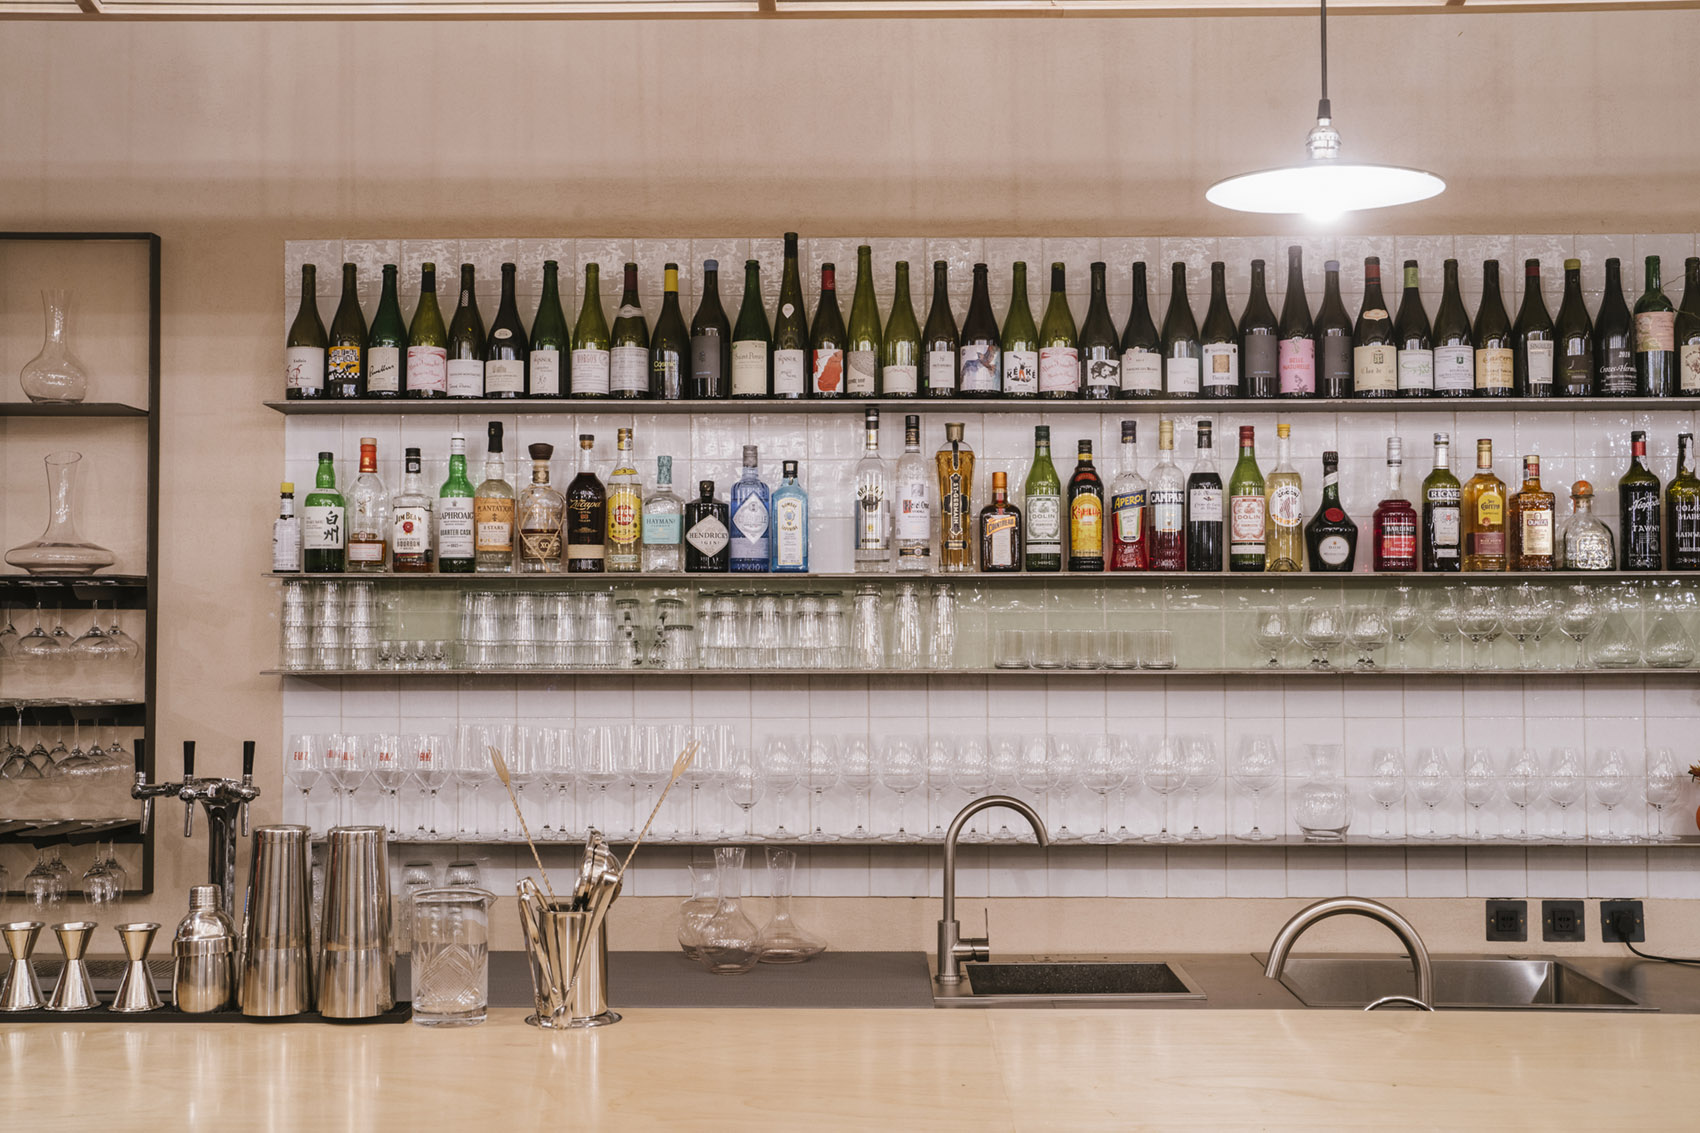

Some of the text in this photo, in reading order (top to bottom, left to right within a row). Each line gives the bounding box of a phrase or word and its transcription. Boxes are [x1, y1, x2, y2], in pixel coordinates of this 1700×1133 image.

[1150, 492, 1184, 503] CAMPAR
[1430, 490, 1460, 499] RICAR
[1114, 494, 1144, 509] APEROL
[394, 511, 422, 525] JIM BEAM
[323, 510, 339, 544] 白州
[460, 528, 472, 536] CASK
